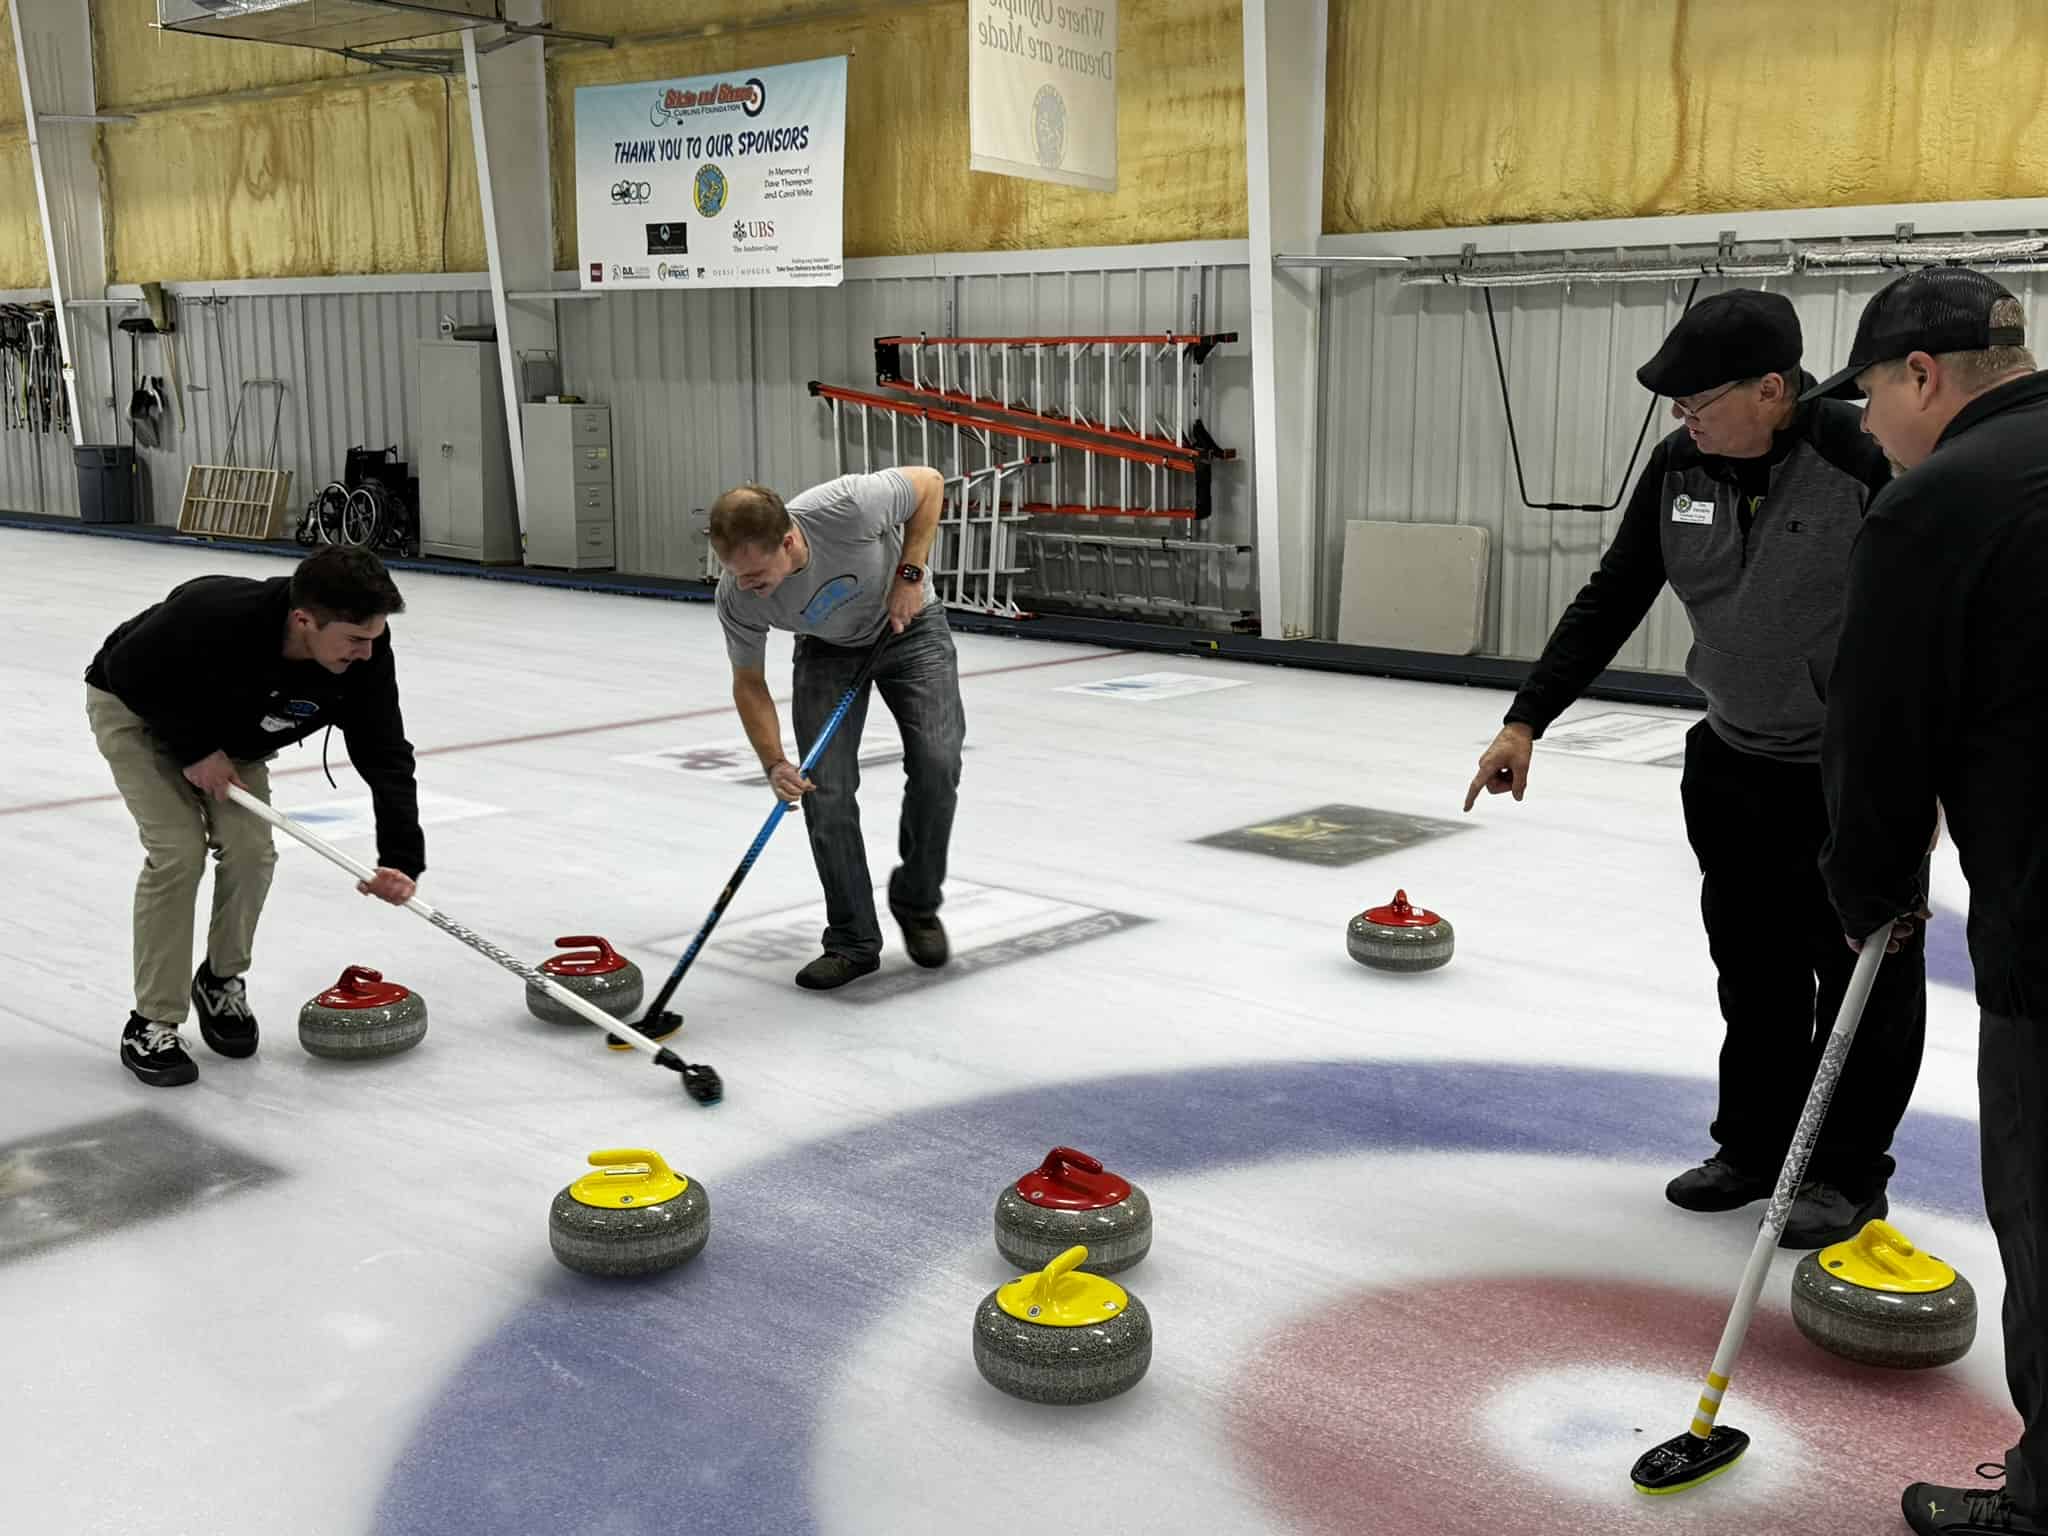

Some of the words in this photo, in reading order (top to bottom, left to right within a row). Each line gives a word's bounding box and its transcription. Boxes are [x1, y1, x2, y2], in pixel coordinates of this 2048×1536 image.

[701, 102, 741, 115] FOUNDATION
[614, 140, 656, 164] THANK
[658, 137, 682, 162] YOU
[686, 135, 702, 159] TO
[706, 133, 734, 158] OUR
[738, 125, 809, 156] SPONSORS
[775, 167, 802, 177] Memory
[764, 190, 778, 200] and
[747, 220, 775, 239] UBS
